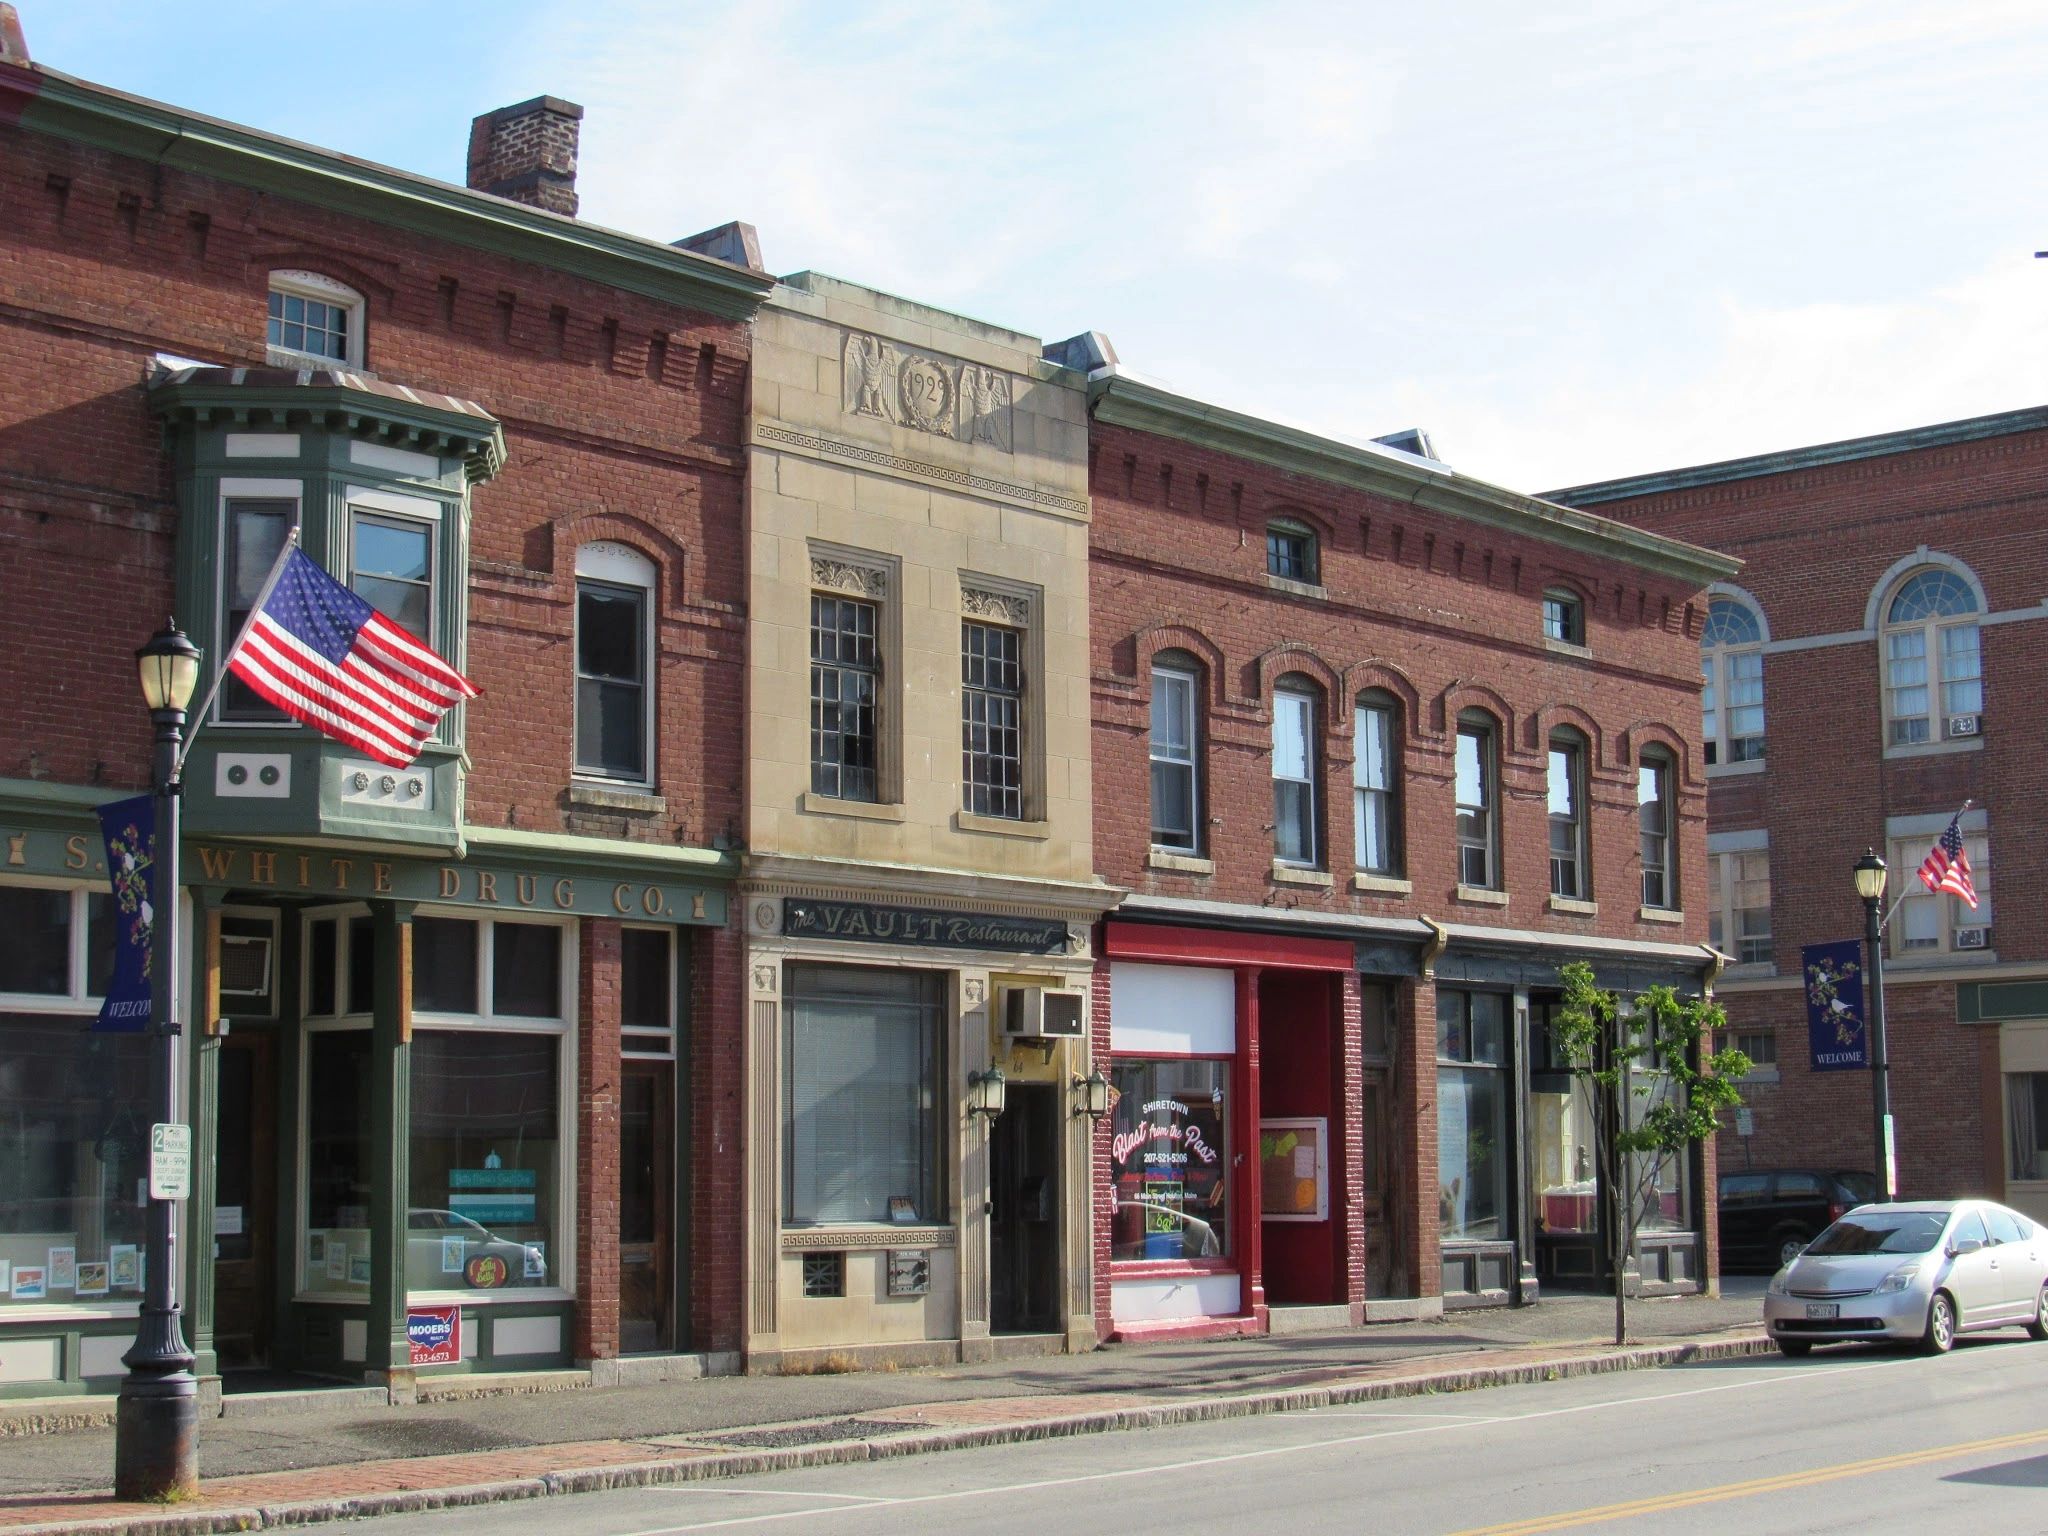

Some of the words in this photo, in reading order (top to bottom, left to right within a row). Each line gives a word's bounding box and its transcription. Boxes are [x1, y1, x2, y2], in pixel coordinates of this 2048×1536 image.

[65, 836, 103, 870] S.
[198, 848, 392, 892] WHITE
[439, 868, 575, 908] DRUG
[613, 884, 673, 916] CO.
[817, 906, 942, 940] VAULT
[947, 917, 1062, 945] Restaurant
[109, 1000, 151, 1017] WELCO
[1817, 1051, 1863, 1064] WELCOME
[1142, 1100, 1189, 1116] SHIRETOWN
[154, 1130, 164, 1148] 2
[1112, 1120, 1147, 1165] Blast
[1149, 1123, 1169, 1140] from
[1169, 1123, 1183, 1140] the
[1185, 1125, 1217, 1163] Past
[1143, 1153, 1188, 1163] 207-521-5206
[409, 1323, 451, 1336] MOOERS
[413, 1351, 450, 1363] 532-6573
